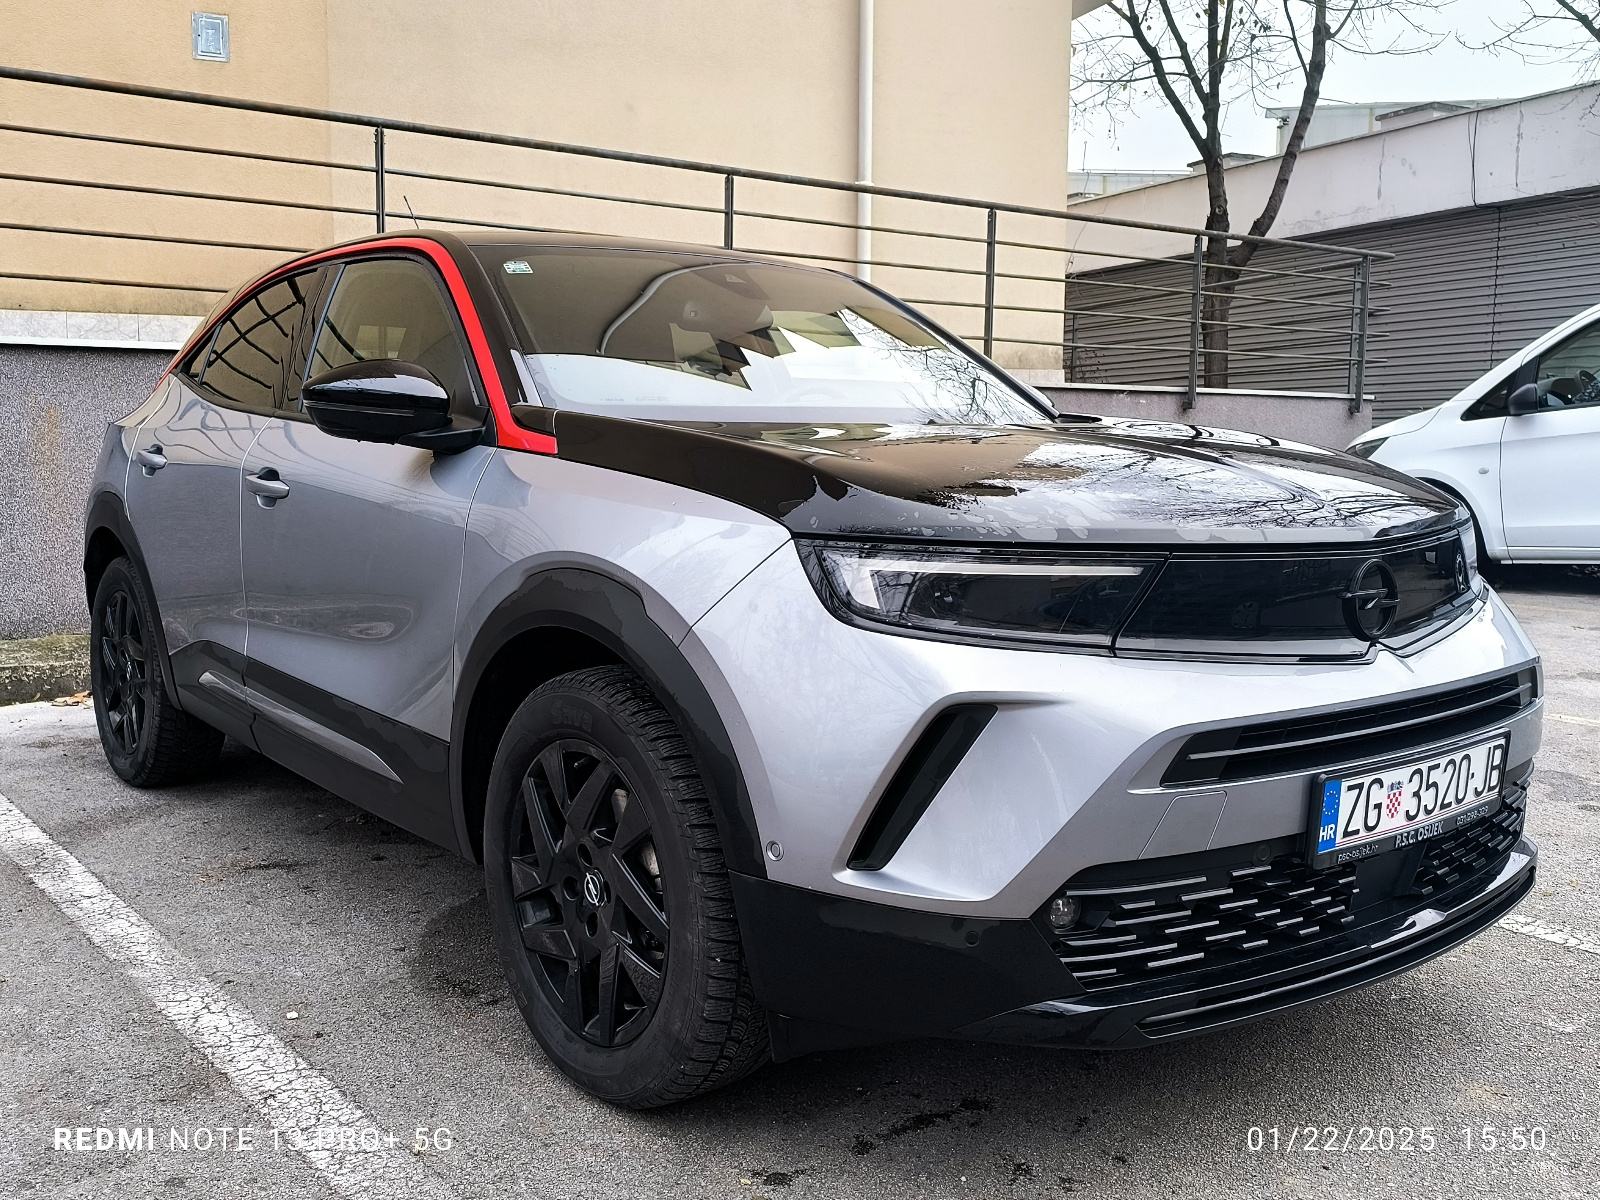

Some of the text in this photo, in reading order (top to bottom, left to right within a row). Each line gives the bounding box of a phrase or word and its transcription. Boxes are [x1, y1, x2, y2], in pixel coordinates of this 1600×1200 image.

[1341, 777, 1384, 839] ZG
[1319, 823, 1336, 842] HR
[1395, 821, 1444, 848] P.S.C. OSIJEK
